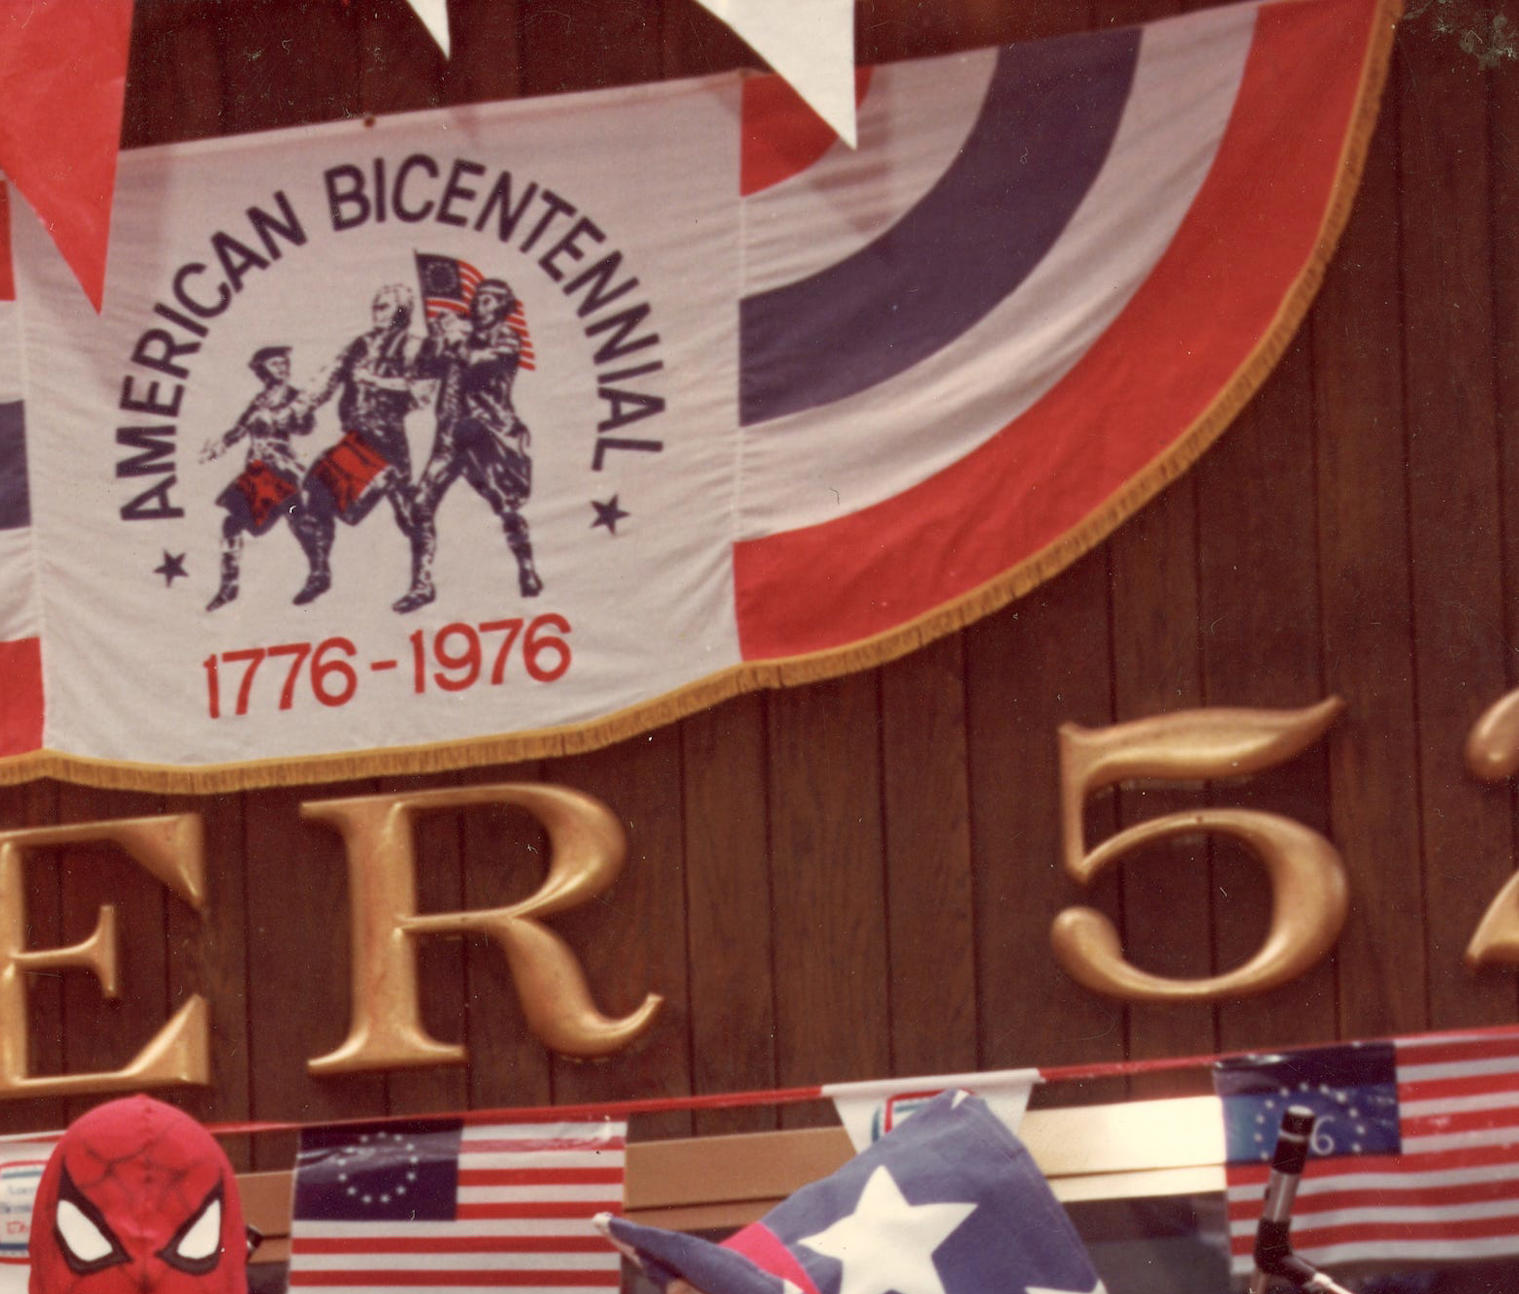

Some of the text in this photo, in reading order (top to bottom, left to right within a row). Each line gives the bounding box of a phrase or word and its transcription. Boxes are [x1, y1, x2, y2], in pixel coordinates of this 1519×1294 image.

[115, 154, 665, 520] AMERICAN BICENTENNIAL
[1050, 686, 1519, 1000] 5
[1309, 1114, 1335, 1156] 6
